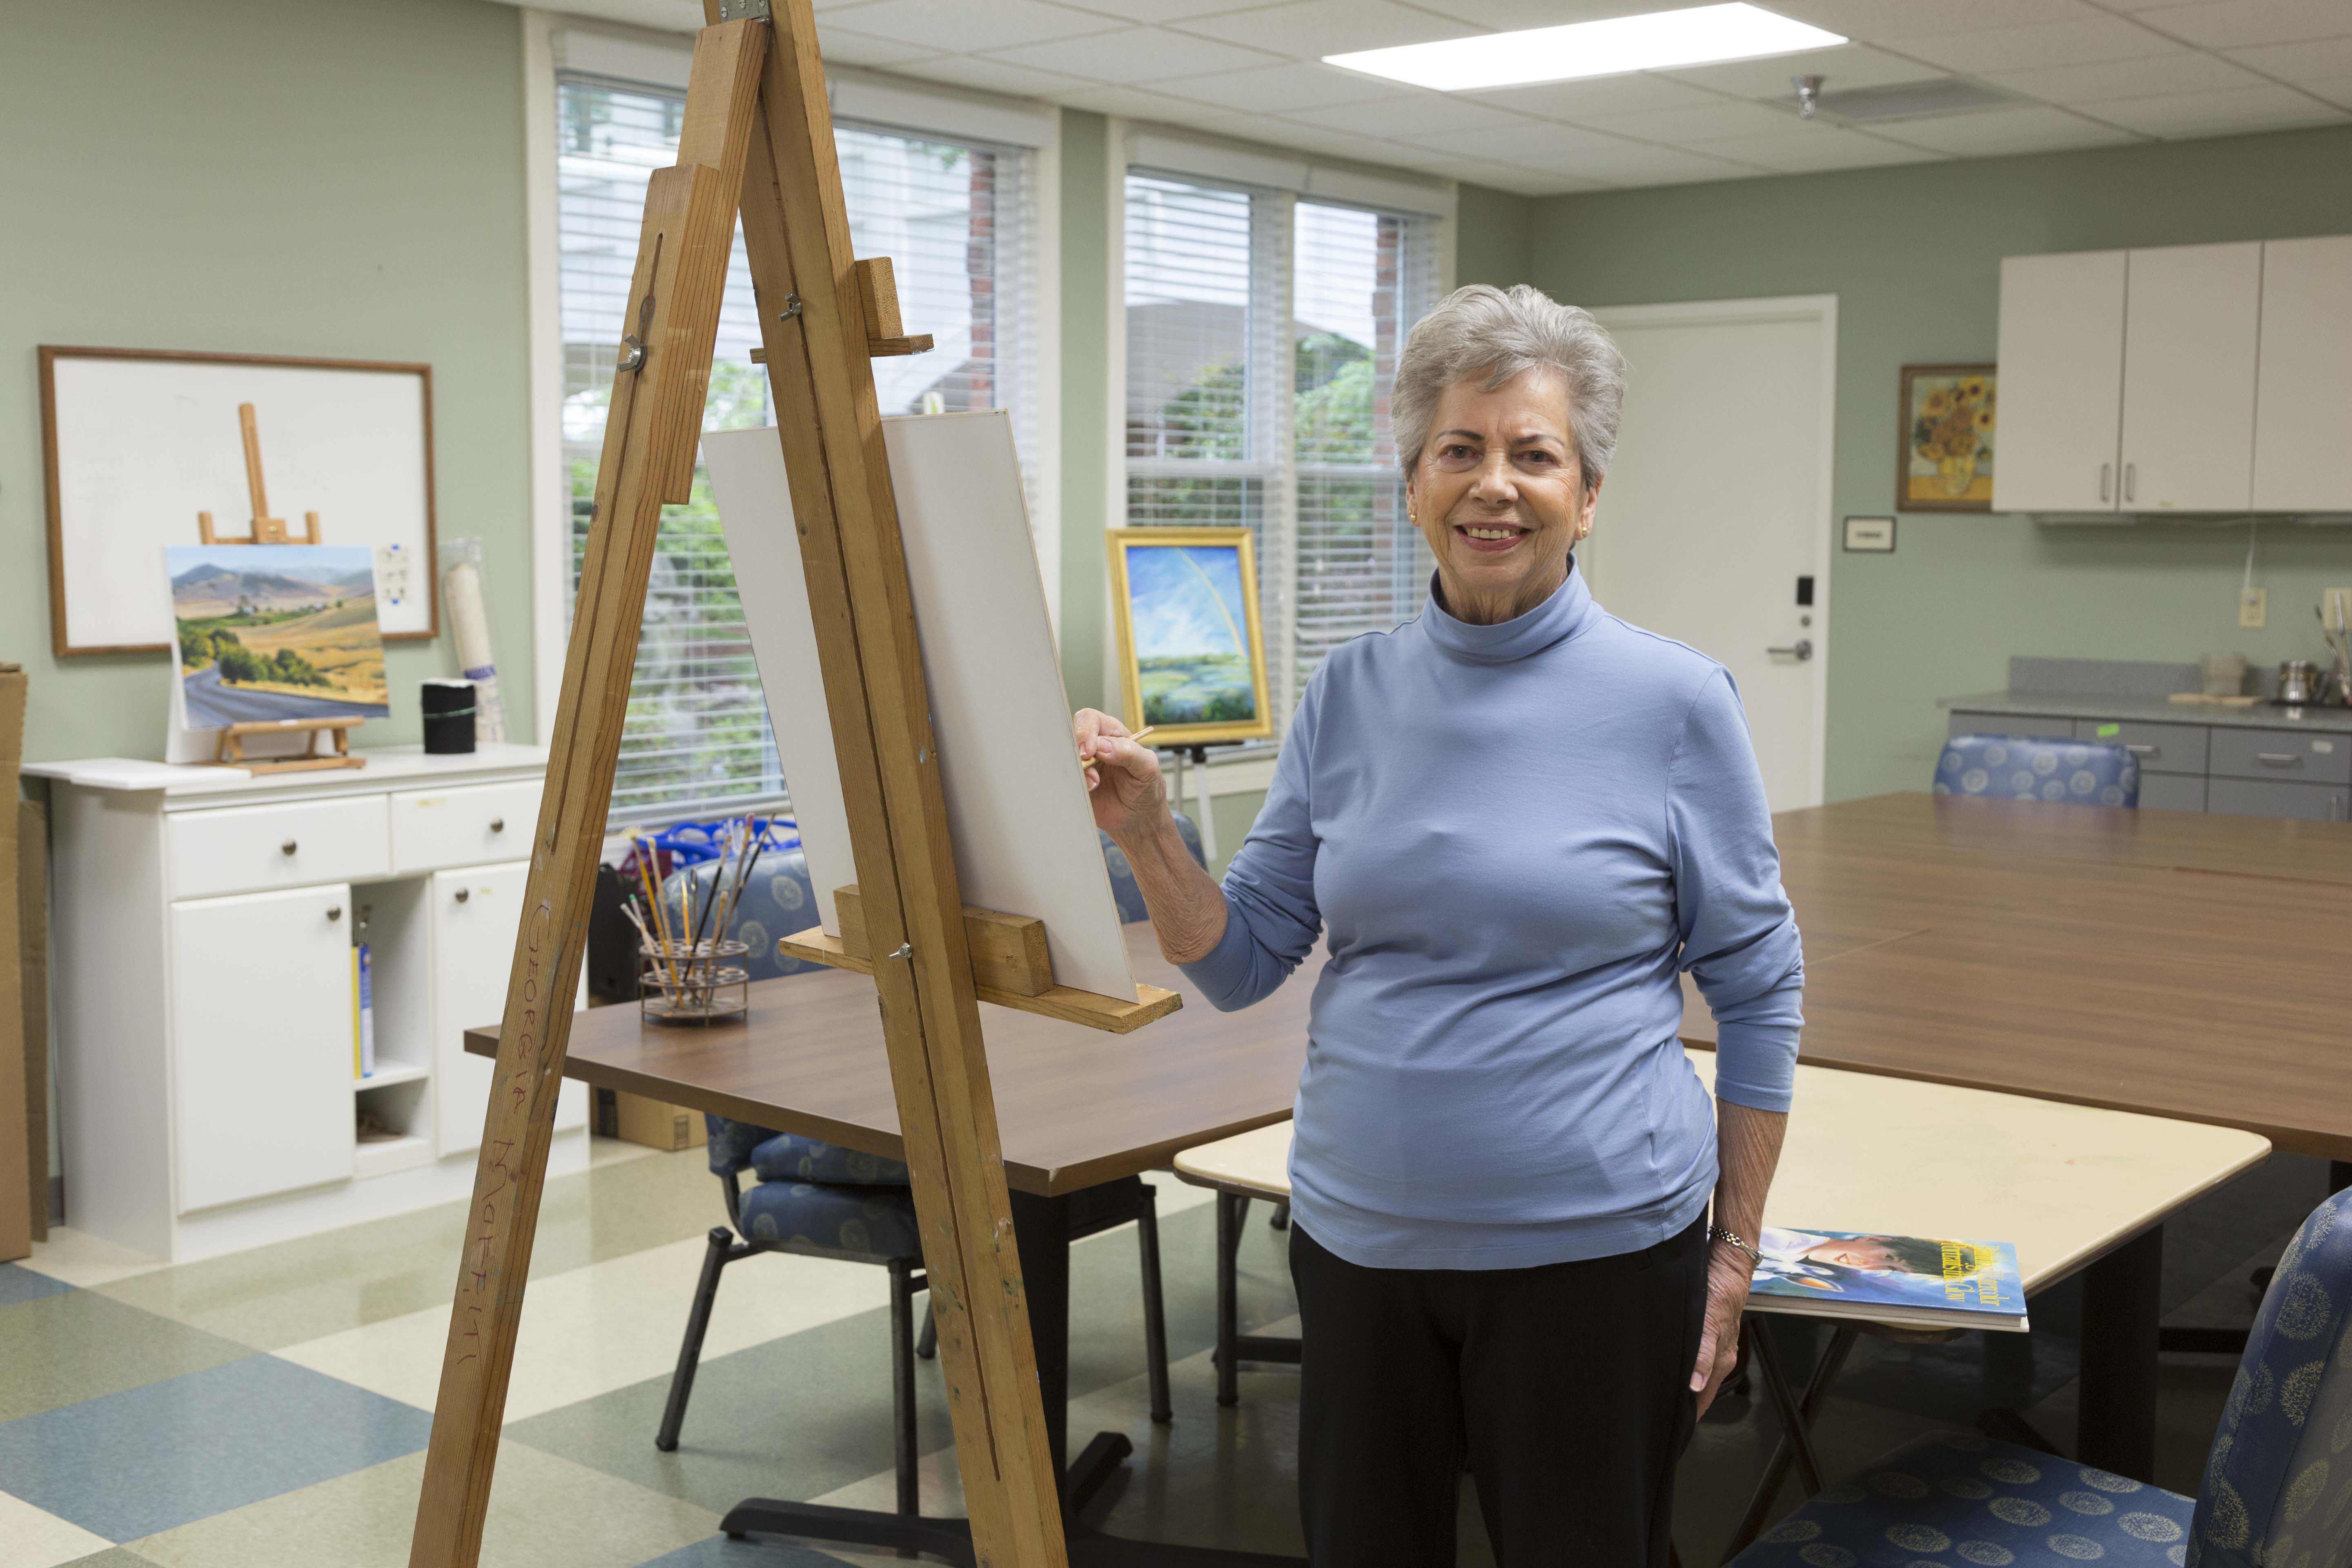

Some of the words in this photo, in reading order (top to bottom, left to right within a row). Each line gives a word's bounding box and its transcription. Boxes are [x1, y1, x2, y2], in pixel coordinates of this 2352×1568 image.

[513, 904, 550, 1114] GEORGIA
[1941, 1242, 1967, 1270] Portraits
[1965, 1245, 1999, 1271] Painting
[1943, 1270, 1973, 1283] that
[1977, 1271, 2009, 1306] Watercolor
[1944, 1283, 1975, 1302] Glow
